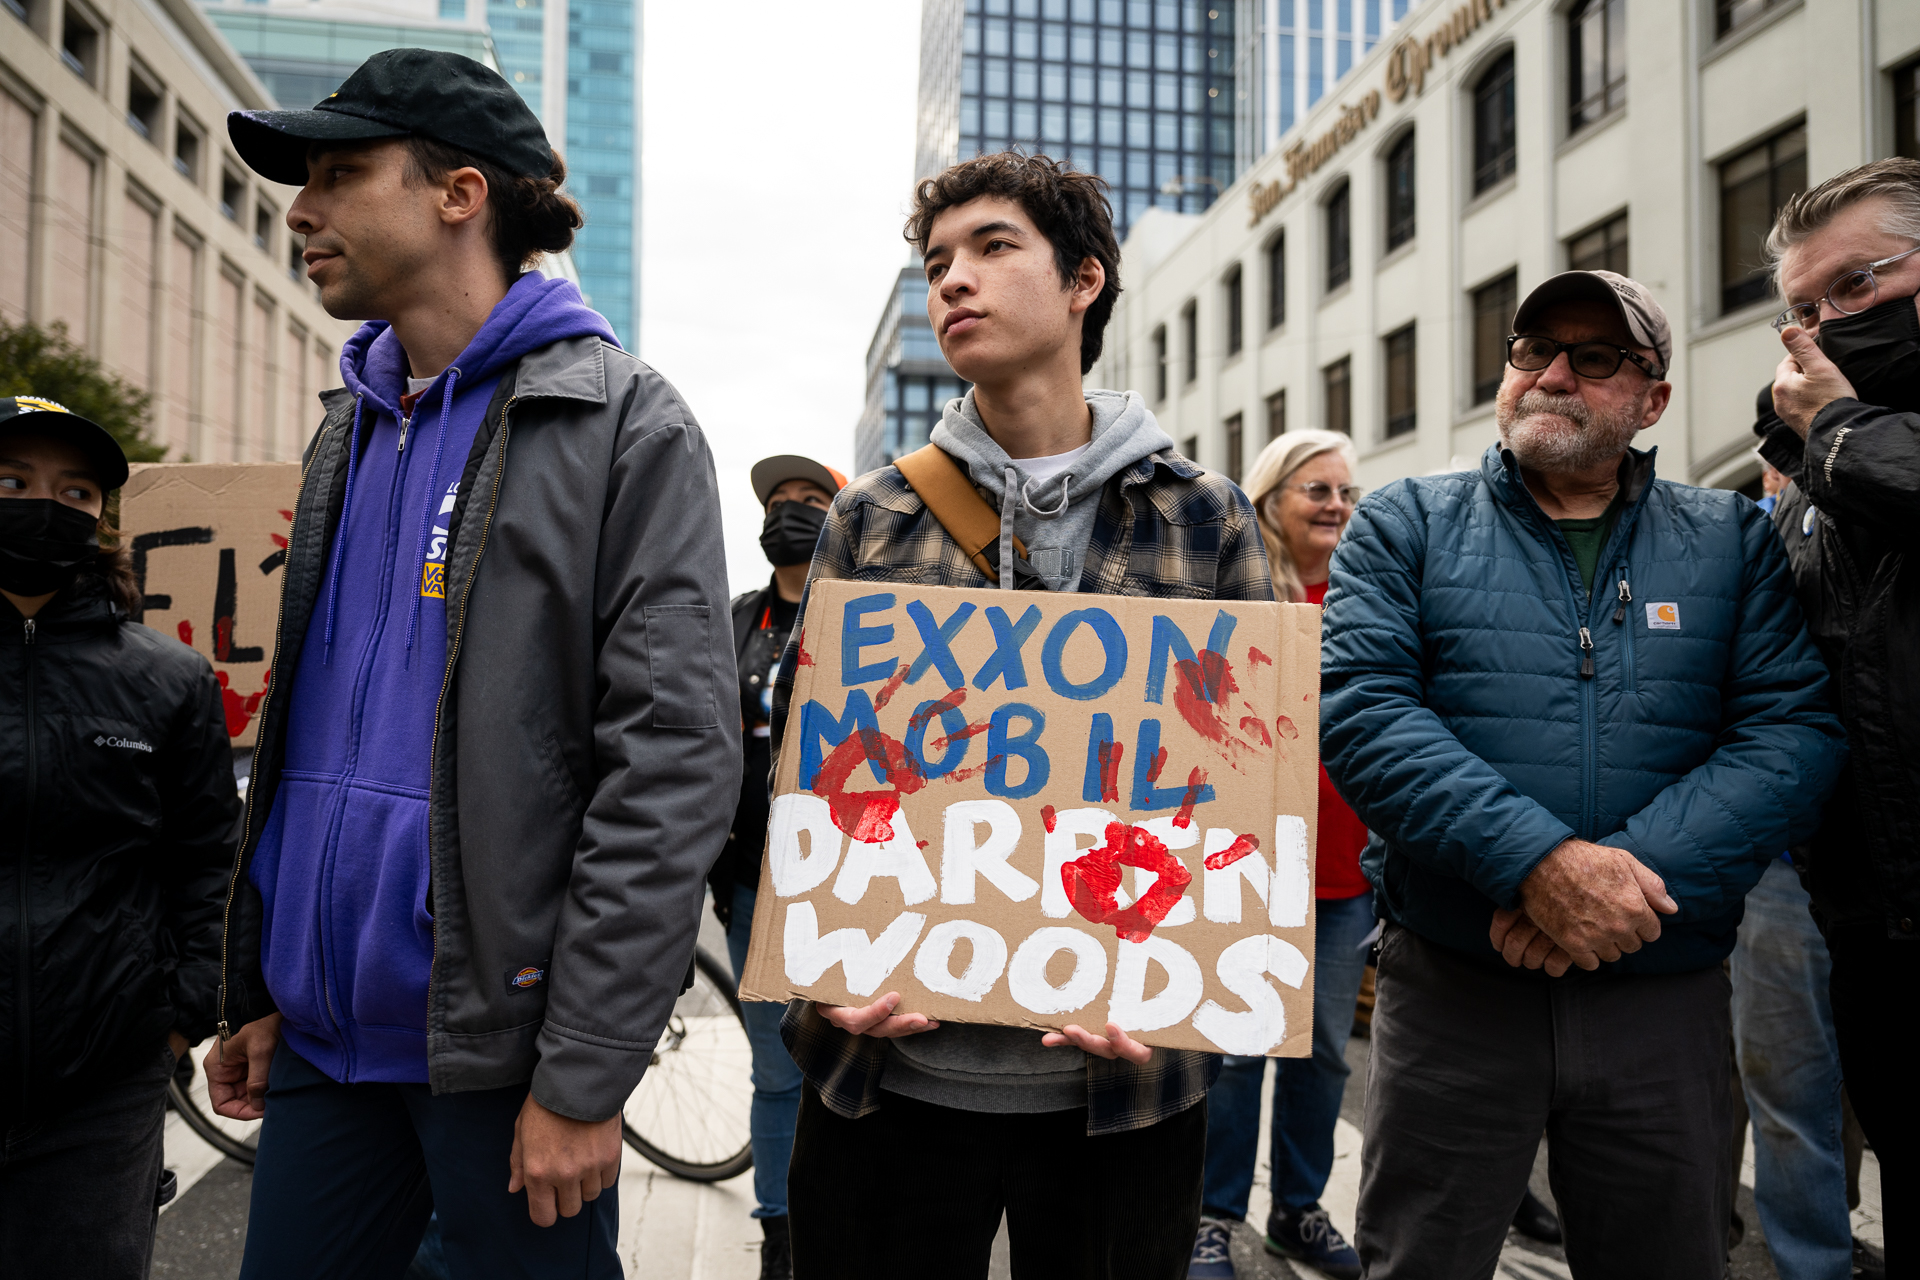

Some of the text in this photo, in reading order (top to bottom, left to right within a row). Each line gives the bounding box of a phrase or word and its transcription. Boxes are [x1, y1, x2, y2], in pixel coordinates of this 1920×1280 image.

[1385, 0, 1506, 104] Chroni
[841, 593, 1238, 705] EXXON
[106, 736, 153, 753] Columbia
[800, 689, 1215, 811] MOBIL
[768, 793, 1309, 928] DARREN
[783, 900, 1310, 1057] WOODS
